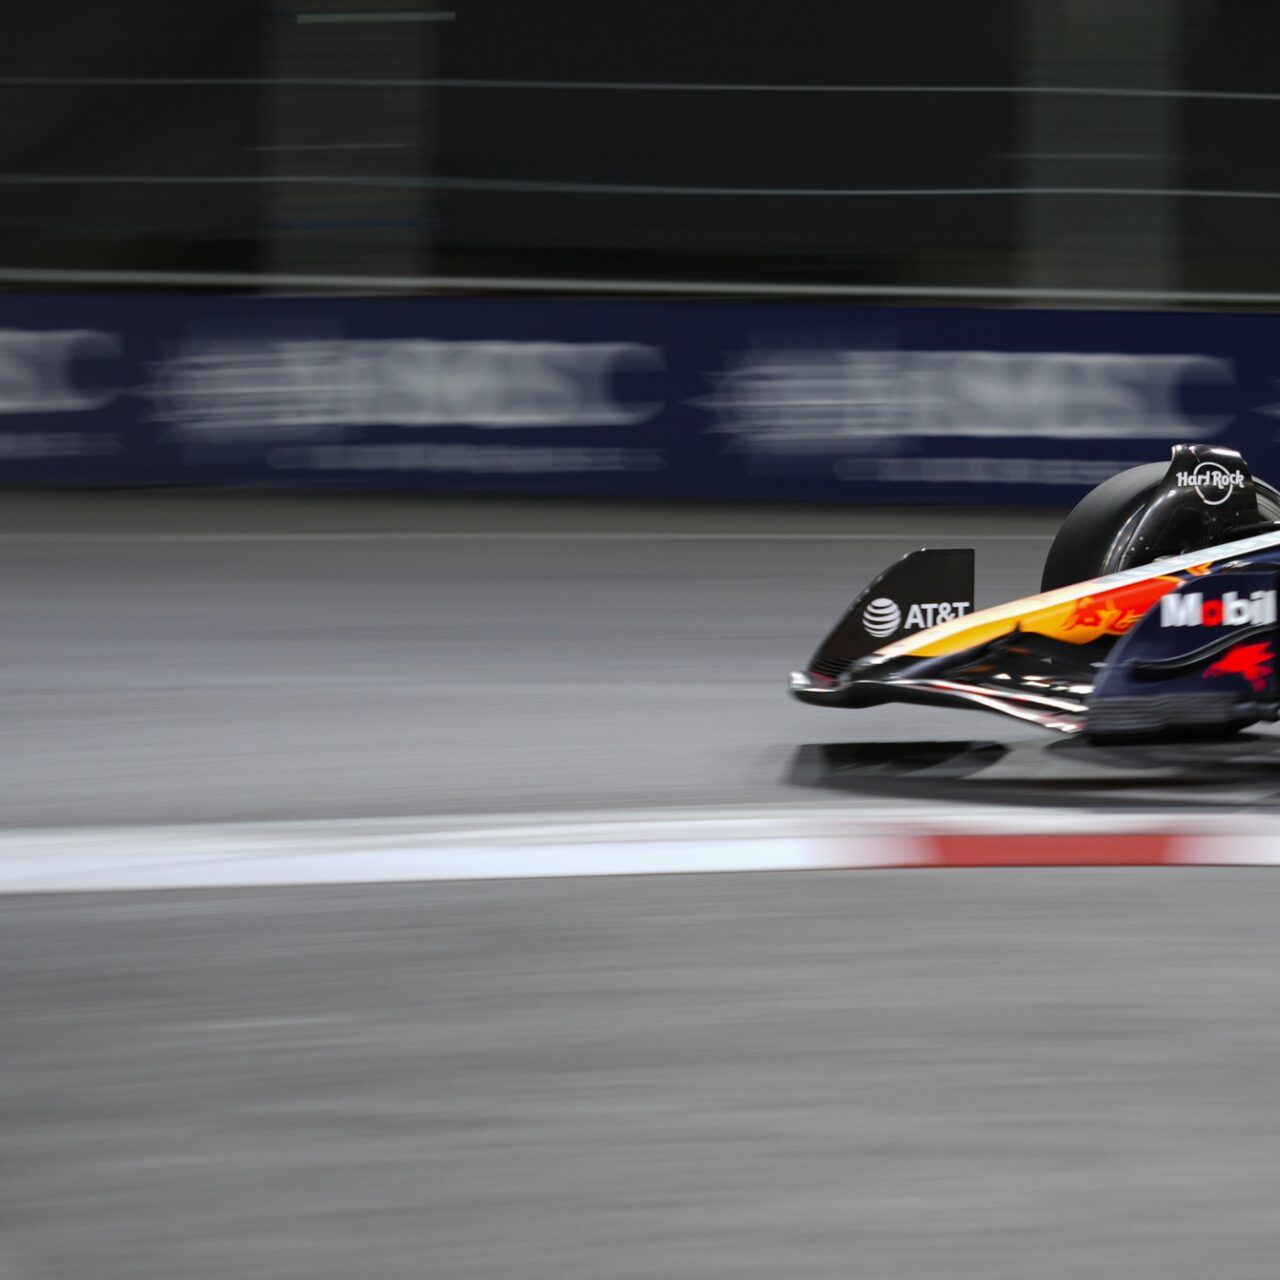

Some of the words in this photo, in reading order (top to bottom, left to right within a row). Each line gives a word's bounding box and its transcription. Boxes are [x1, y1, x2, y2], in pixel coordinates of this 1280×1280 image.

[1176, 471, 1210, 487] Hard
[1210, 470, 1245, 489] Rock
[904, 602, 970, 629] AT&T
[1160, 590, 1277, 628] Mobil
